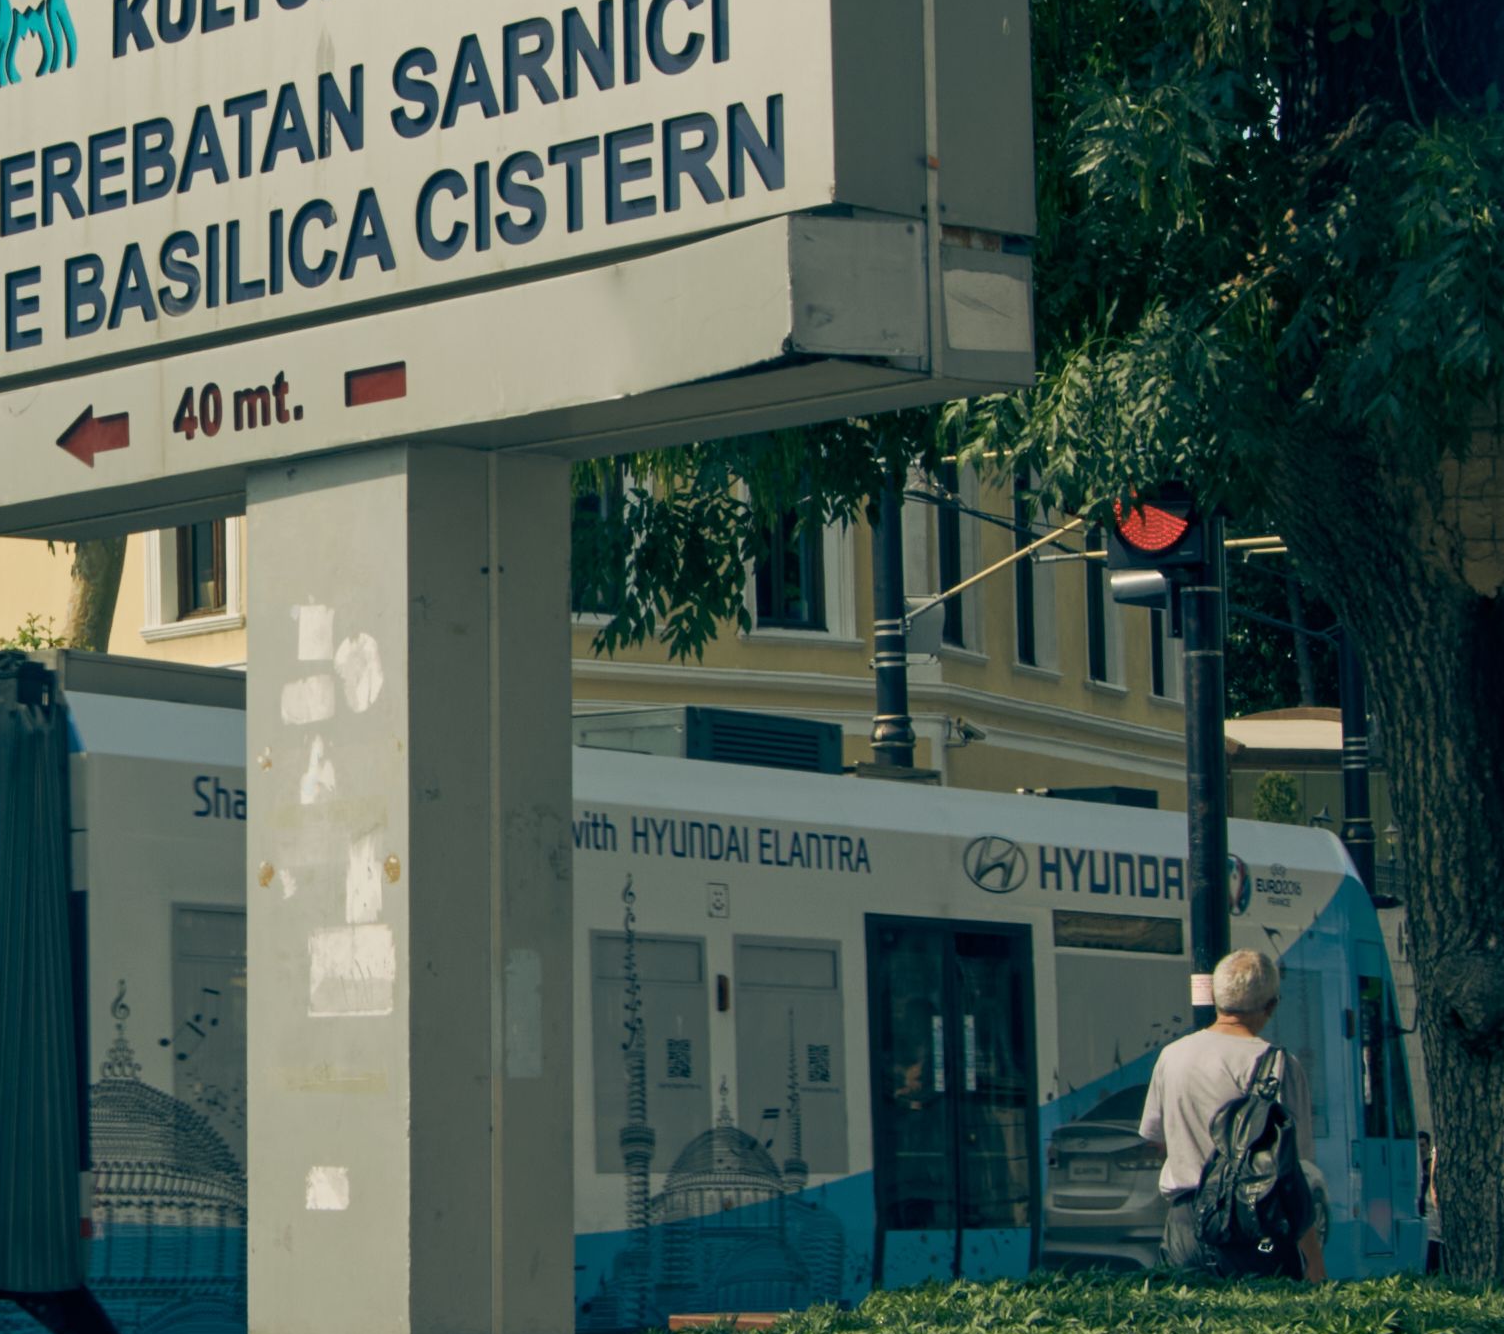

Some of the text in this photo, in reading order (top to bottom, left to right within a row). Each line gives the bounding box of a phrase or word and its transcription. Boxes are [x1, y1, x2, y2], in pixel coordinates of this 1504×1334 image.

[65, 187, 397, 340] BASILICA
[415, 93, 787, 261] CISTERN
[173, 370, 304, 440] 40 mt.
[632, 816, 749, 863] HYUNDAI
[758, 828, 872, 874] ELANTRA
